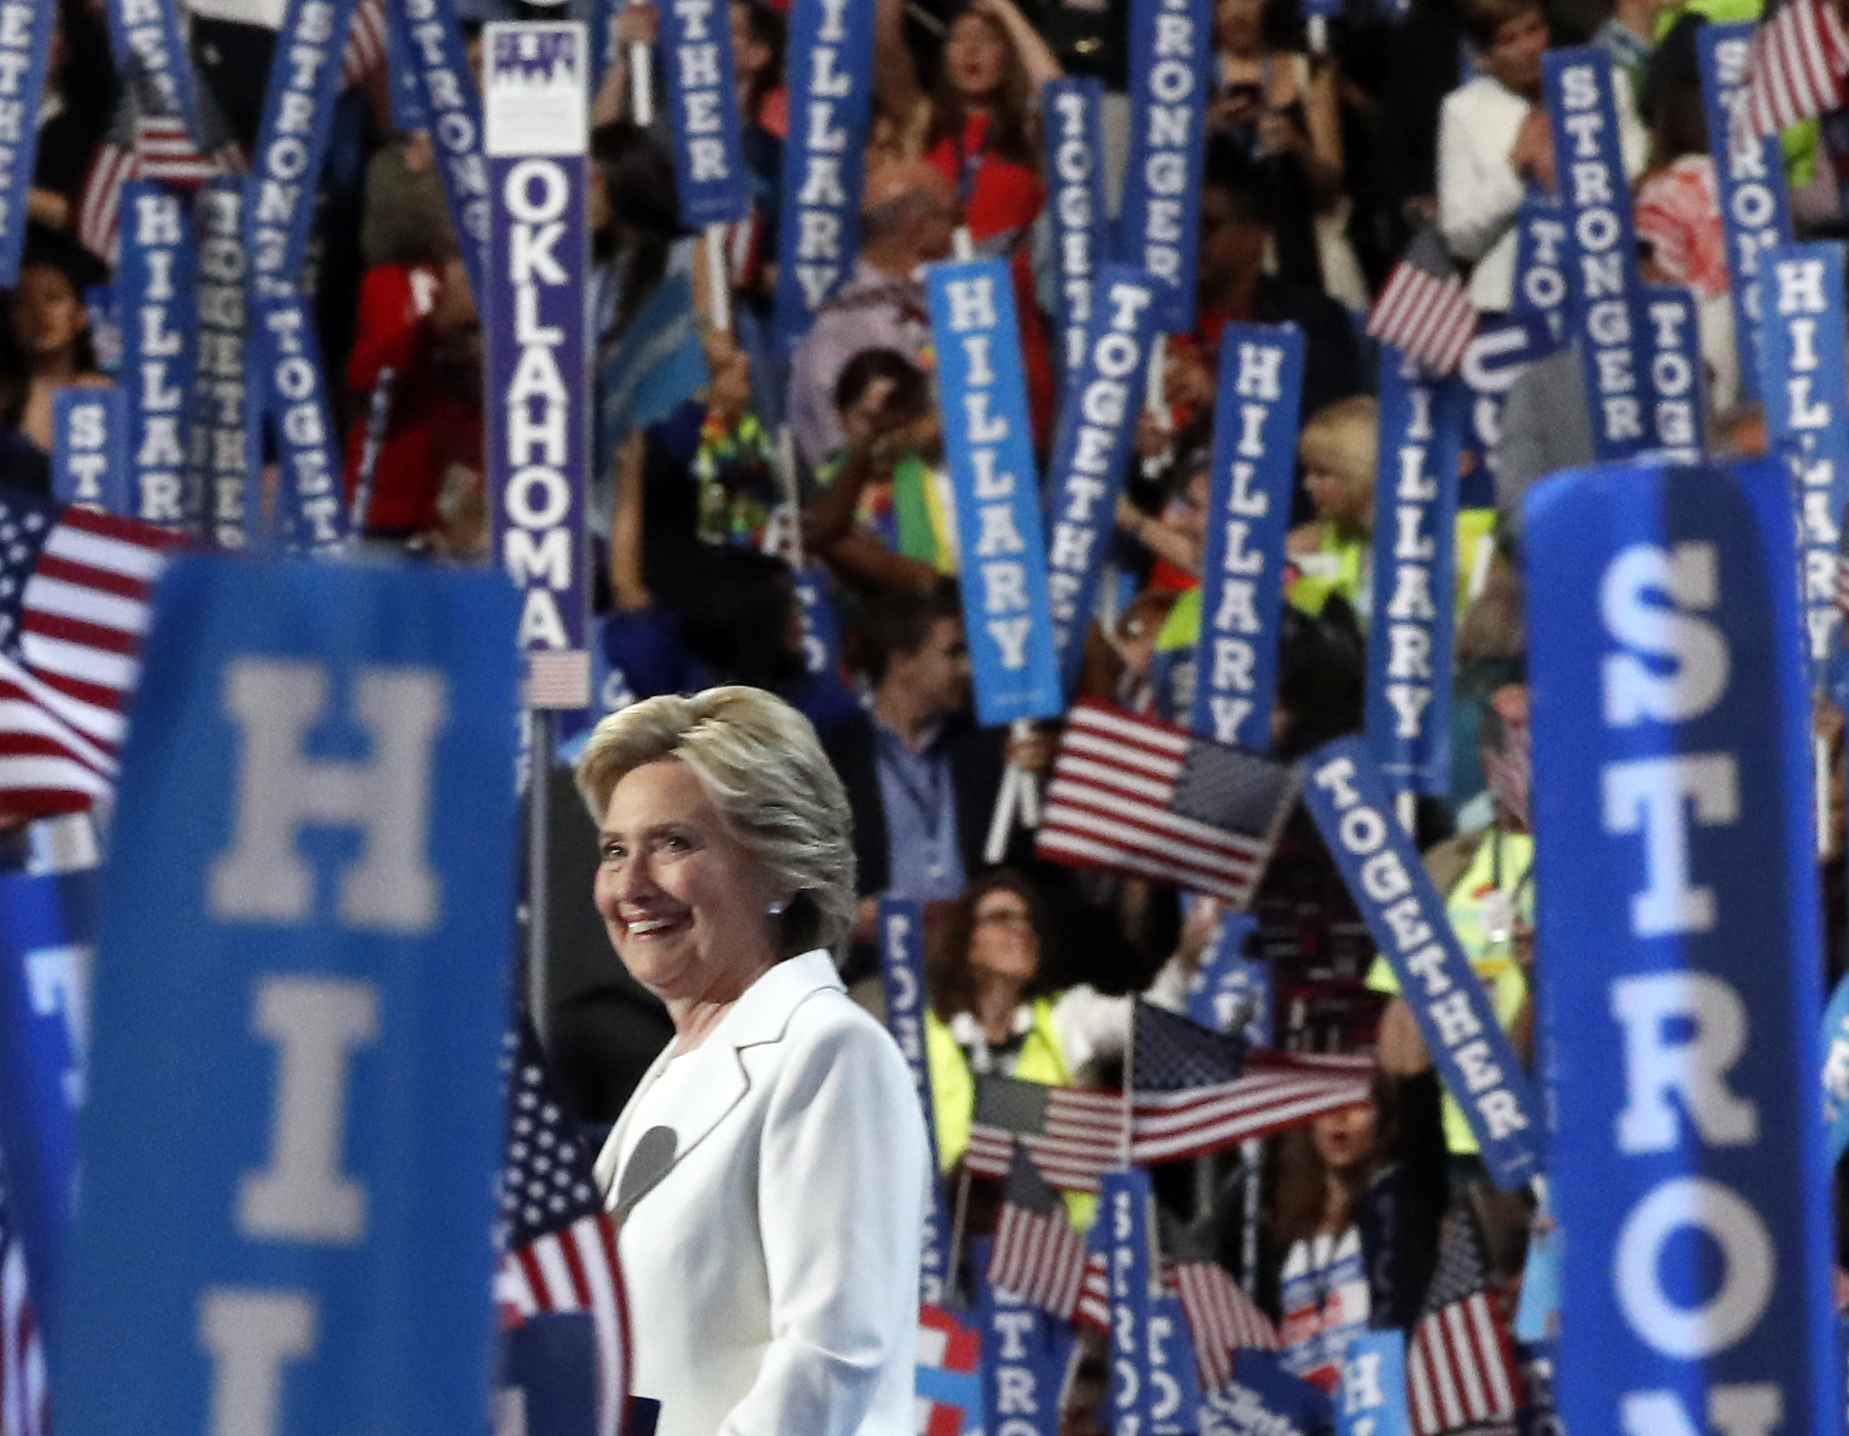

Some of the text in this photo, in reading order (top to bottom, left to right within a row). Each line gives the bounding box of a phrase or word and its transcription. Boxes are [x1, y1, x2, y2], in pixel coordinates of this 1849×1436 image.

[502, 159, 573, 650] OKLAHOMA
[1559, 64, 1643, 440] STRONGER
[945, 275, 1032, 670] HILLARY
[1209, 342, 1284, 746] HILLARY
[1315, 757, 1530, 1142] TOGETHER
